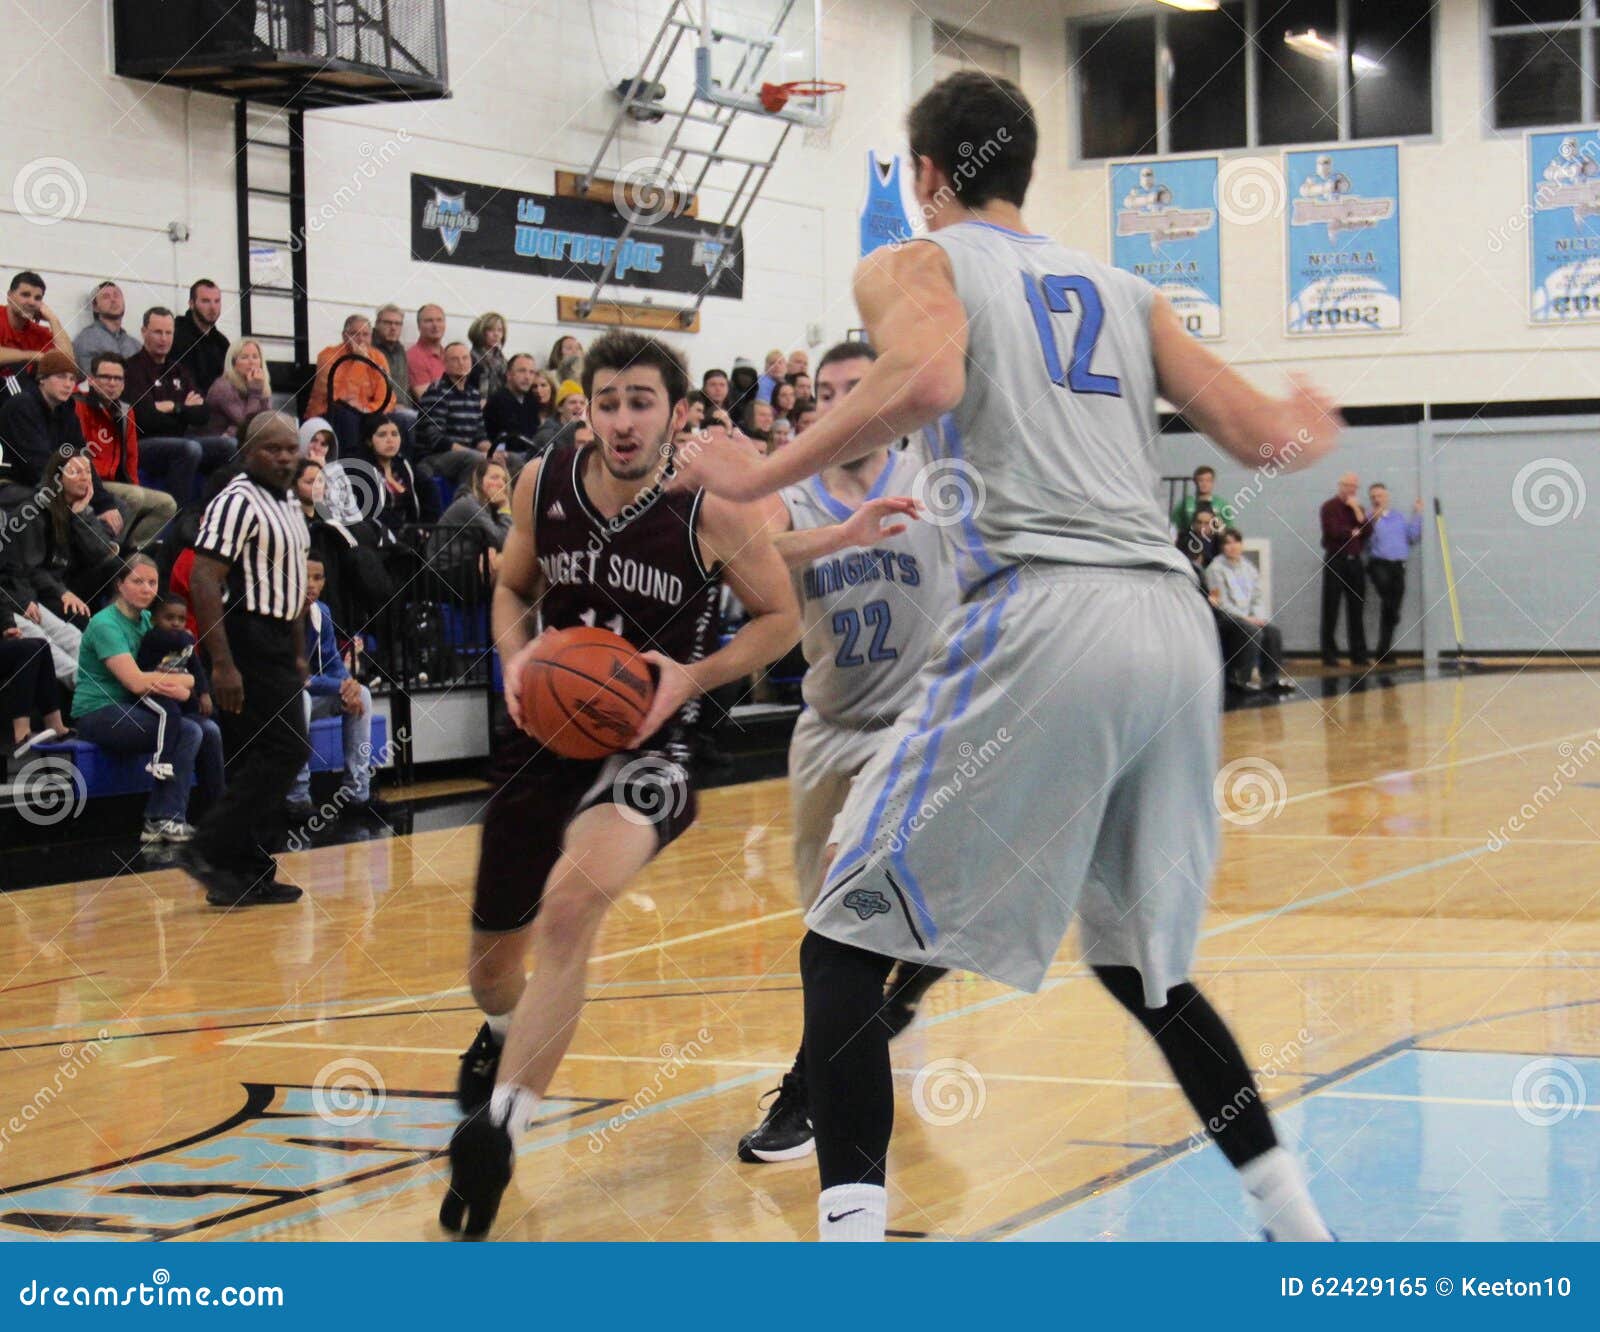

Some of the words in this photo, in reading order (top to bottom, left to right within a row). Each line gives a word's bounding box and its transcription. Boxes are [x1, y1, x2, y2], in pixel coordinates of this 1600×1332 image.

[1020, 270, 1123, 399] 12
[607, 553, 683, 606] SOUND
[832, 599, 899, 668] 22
